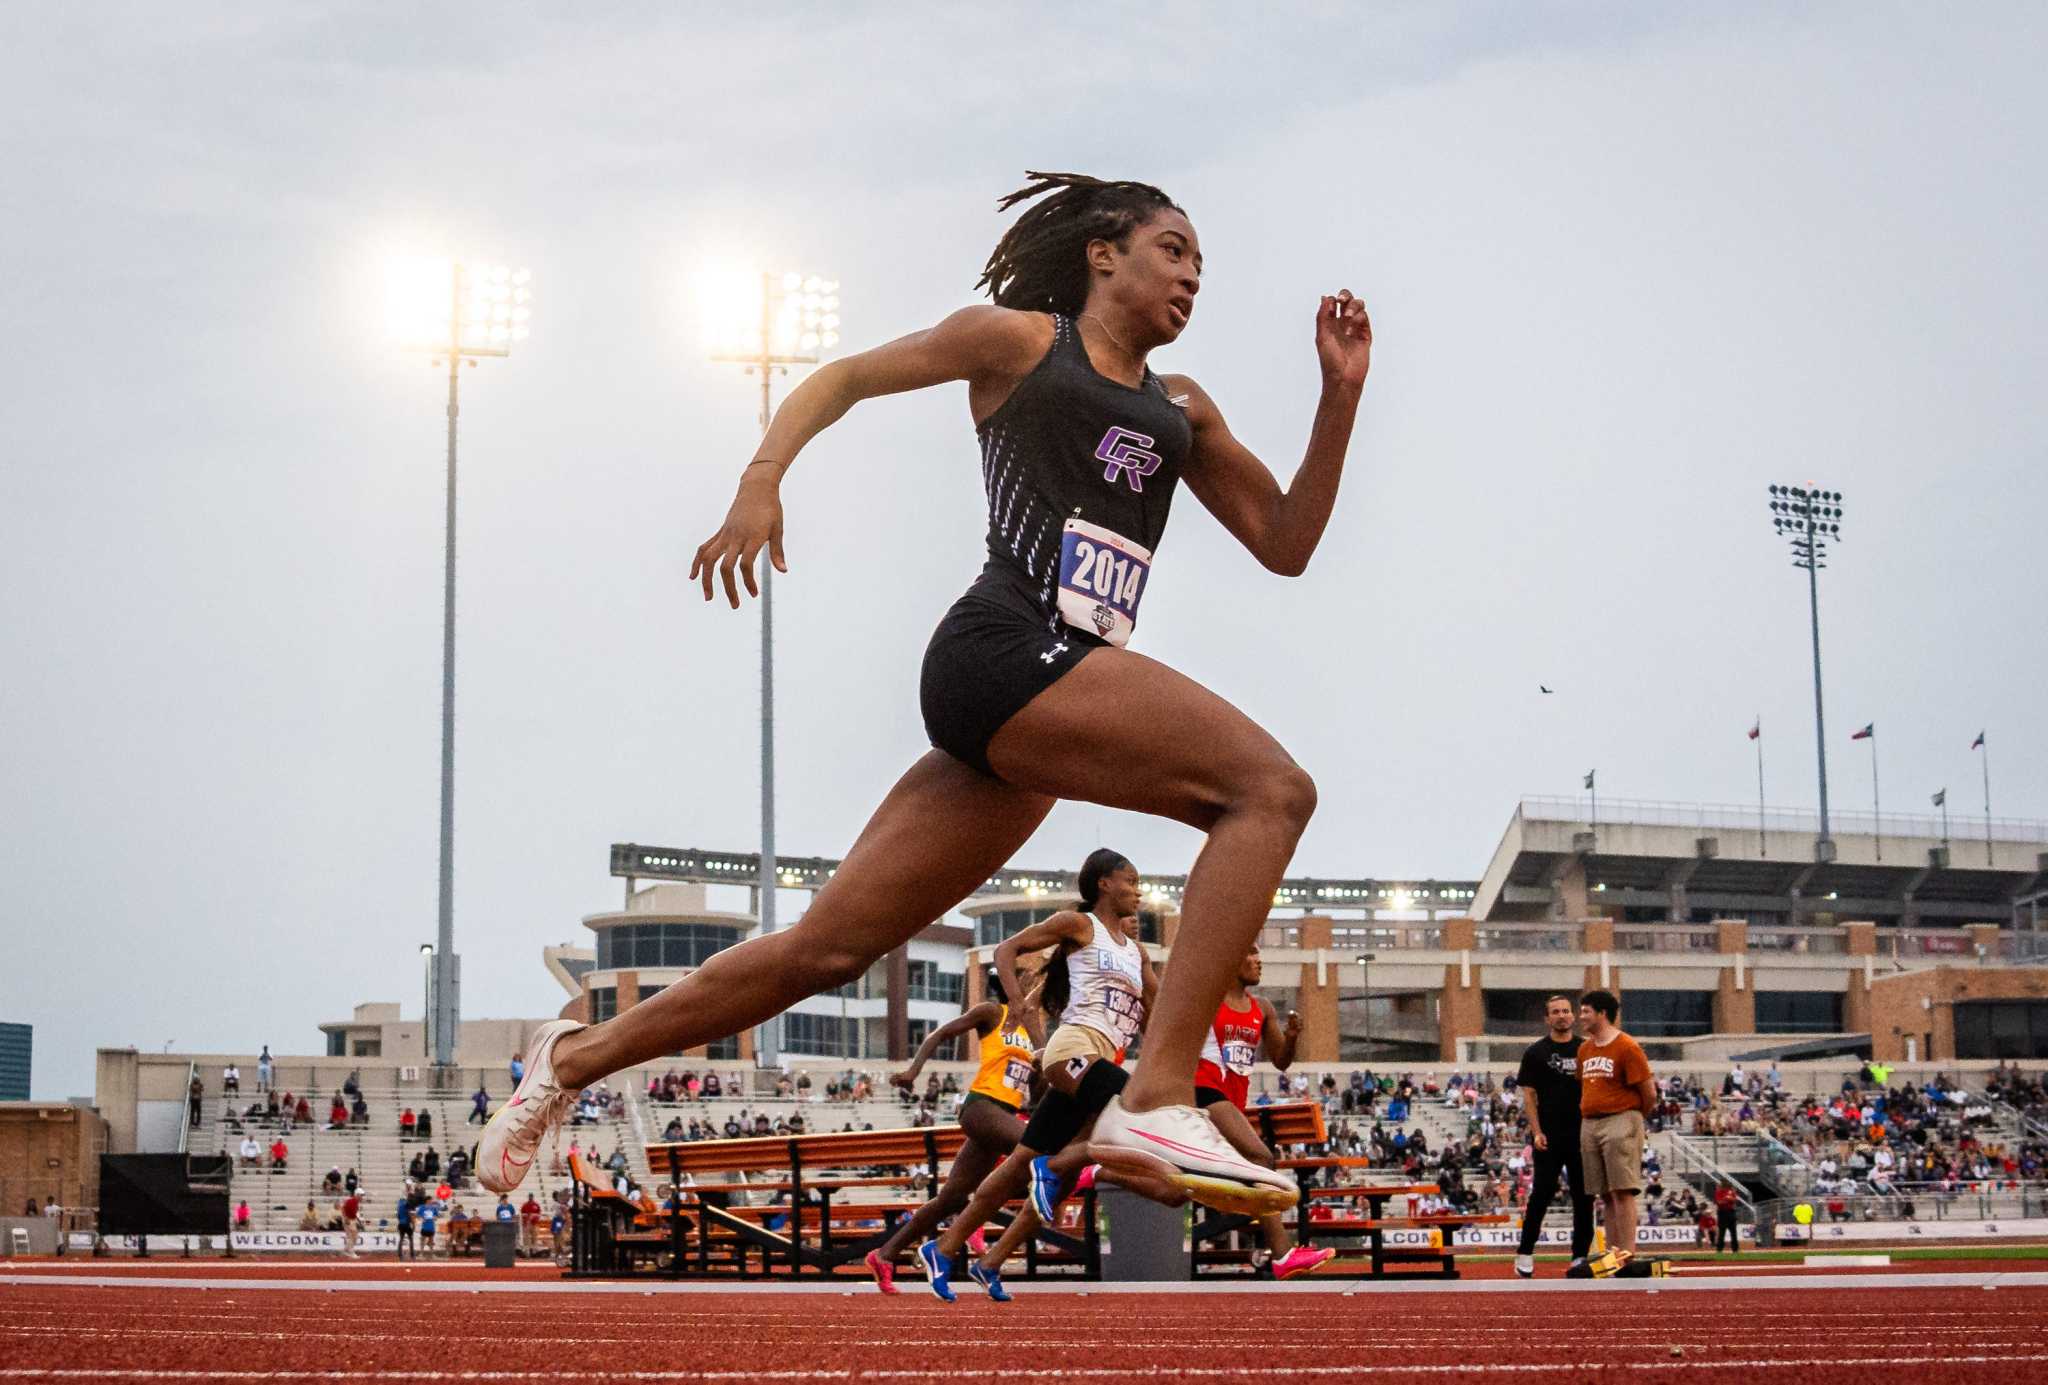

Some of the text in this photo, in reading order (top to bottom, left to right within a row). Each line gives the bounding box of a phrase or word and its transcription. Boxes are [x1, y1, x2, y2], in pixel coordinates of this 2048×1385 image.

[1071, 541, 1142, 610] 2014
[1226, 1046, 1253, 1066] 1642
[1582, 1056, 1614, 1073] TEXAS
[235, 1235, 331, 1246] WELCOME
[1457, 1231, 1482, 1243] TO
